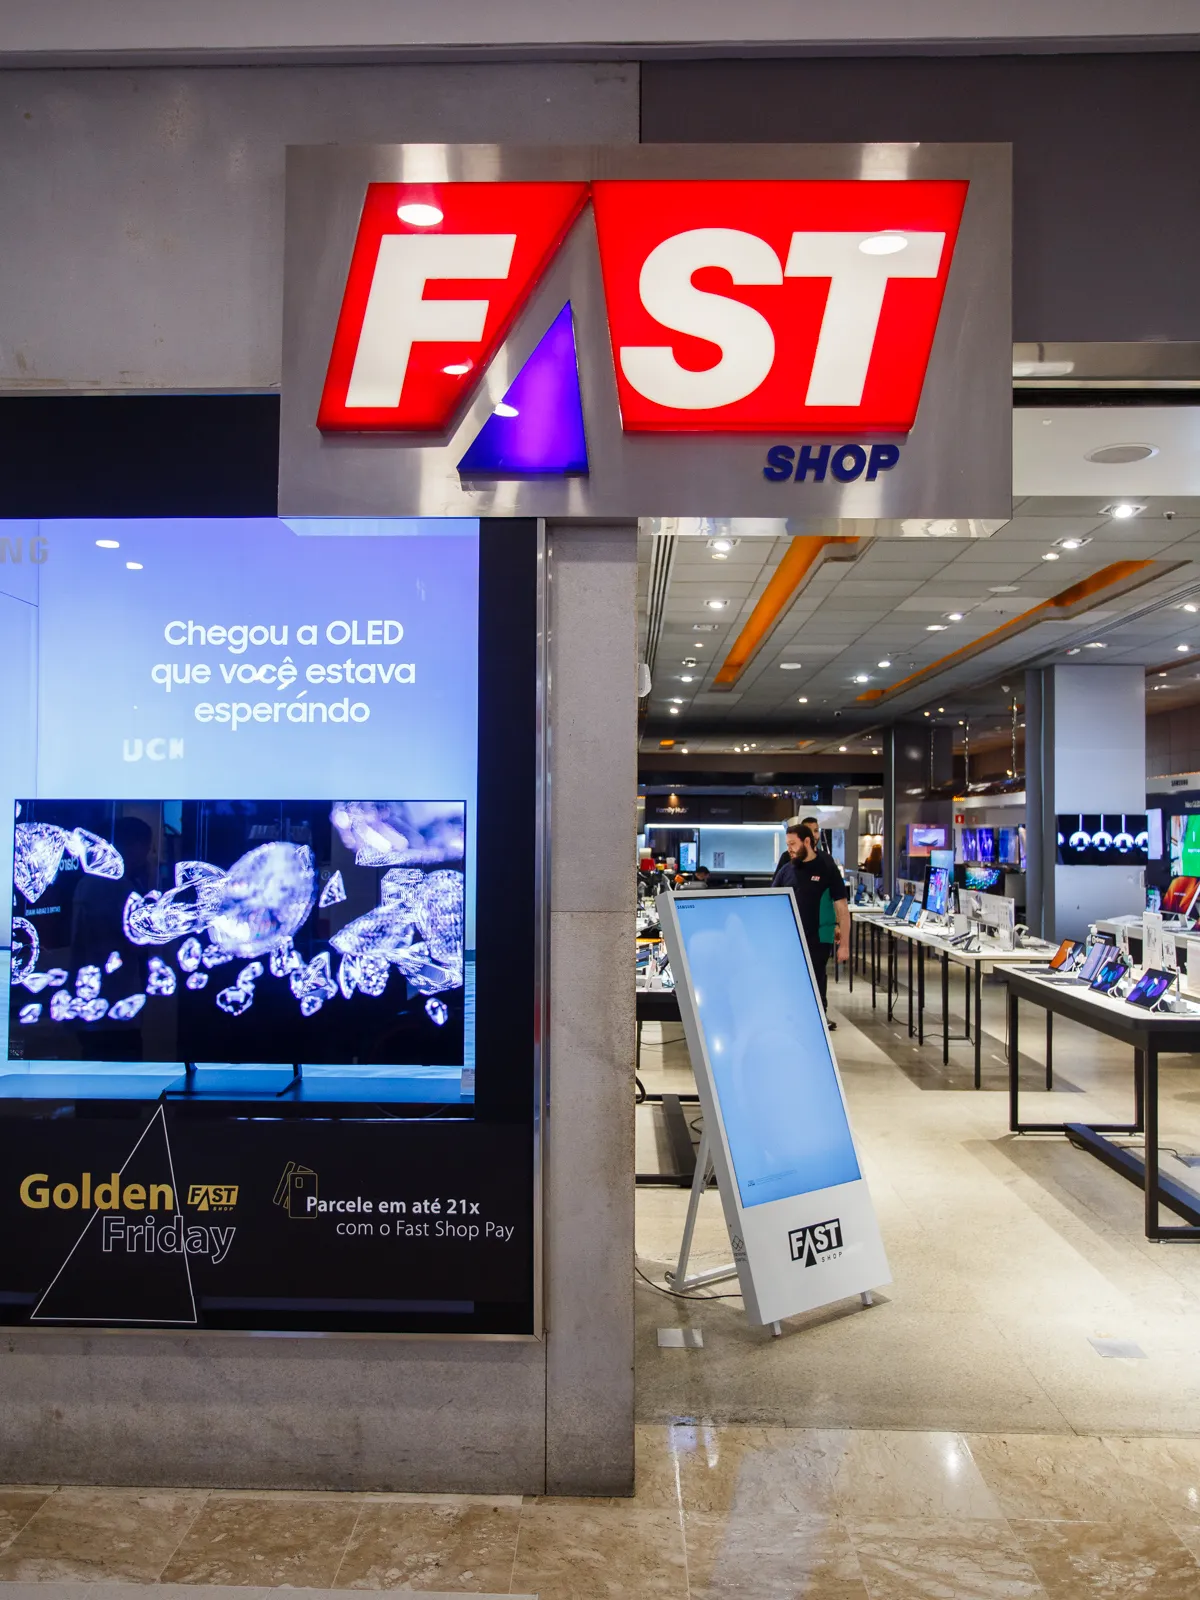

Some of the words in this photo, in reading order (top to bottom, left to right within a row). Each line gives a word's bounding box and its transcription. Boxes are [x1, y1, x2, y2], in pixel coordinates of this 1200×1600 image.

[340, 195, 948, 478] FAST
[763, 444, 900, 483] SHOP
[164, 620, 288, 653] Chegou
[297, 625, 318, 646] a
[326, 620, 404, 646] OLED
[151, 663, 211, 692] que
[220, 656, 298, 686] você
[305, 657, 416, 685] estava
[20, 1172, 174, 1211] Golden
[188, 1185, 238, 1211] FAST
[306, 1196, 373, 1214] Parcele
[379, 1200, 406, 1214] em
[412, 1198, 441, 1215] até
[447, 1199, 480, 1215] 21x
[102, 1215, 237, 1263] Friday
[336, 1224, 373, 1237] com
[379, 1225, 391, 1237] o
[396, 1221, 429, 1237] Fast
[435, 1222, 480, 1241] Shop
[486, 1223, 514, 1242] Pay
[788, 1218, 843, 1268] FAST
[821, 1251, 843, 1263] SHOP
